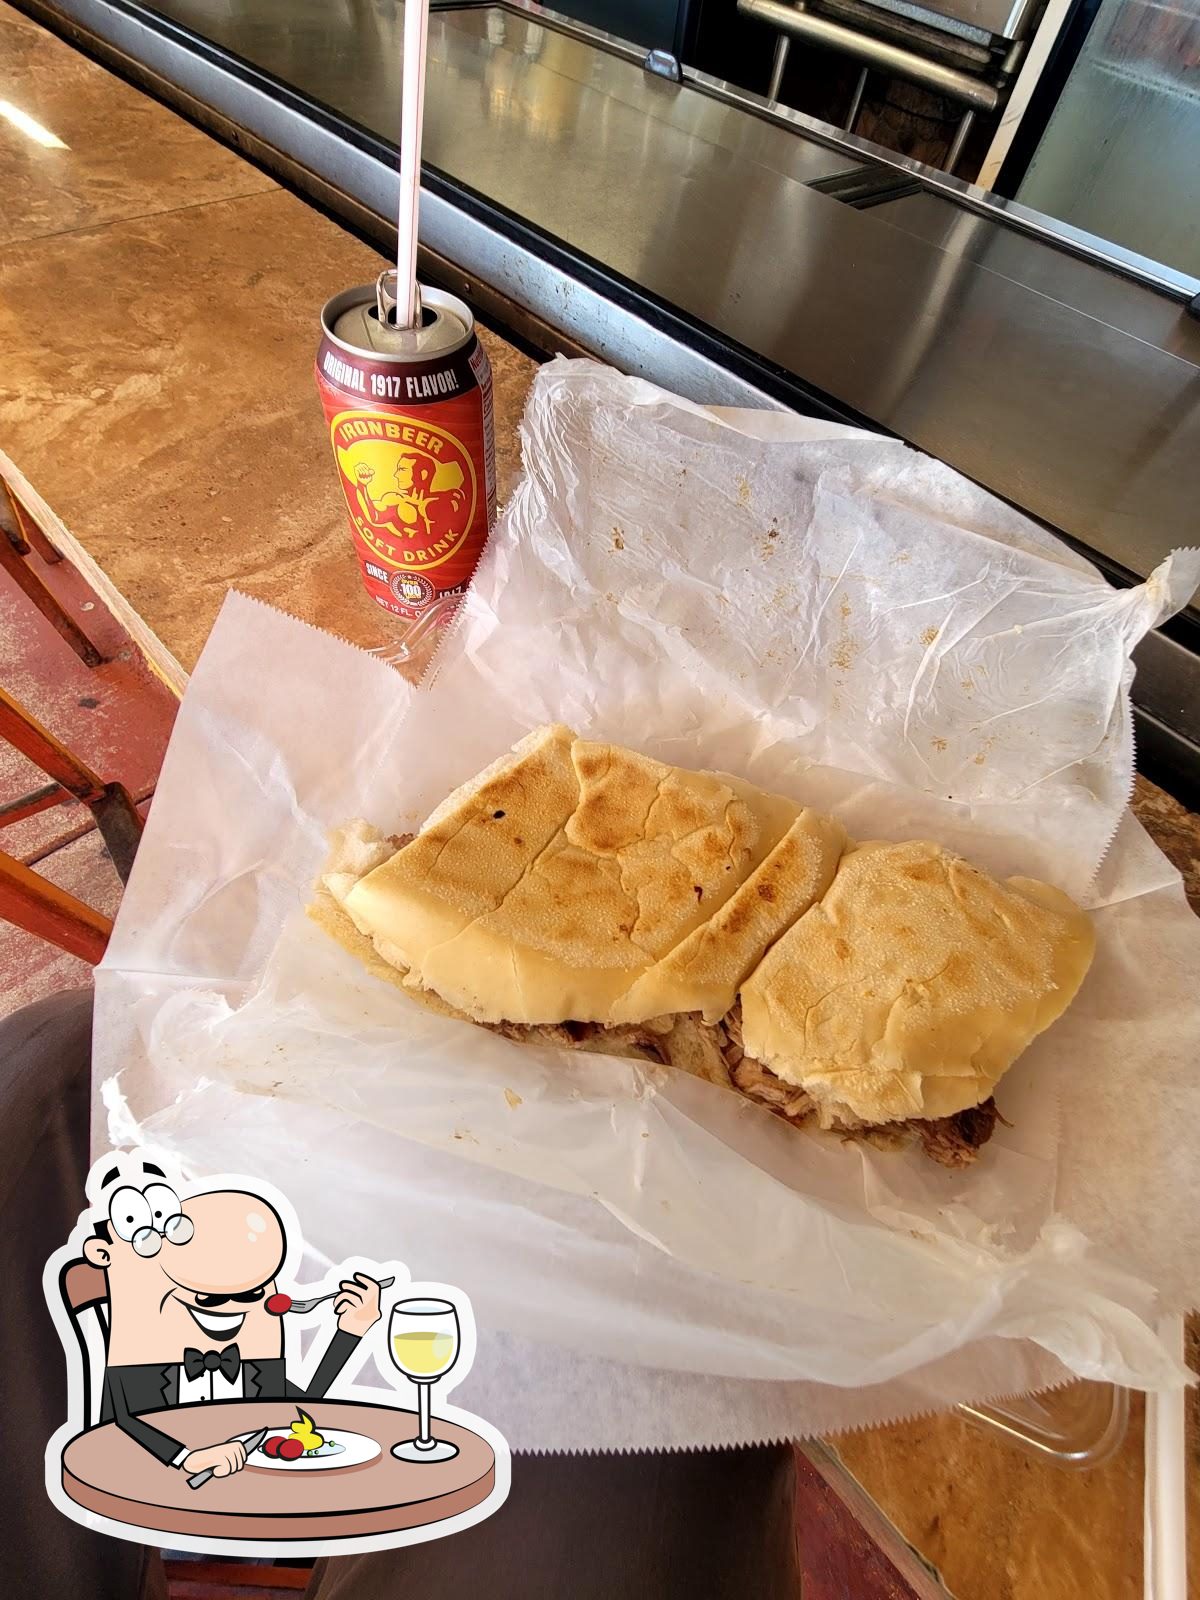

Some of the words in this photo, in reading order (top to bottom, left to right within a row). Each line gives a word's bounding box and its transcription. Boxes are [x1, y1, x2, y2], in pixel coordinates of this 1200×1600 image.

[323, 351, 366, 392] ORIGINAL
[370, 373, 400, 398] 1917
[405, 368, 459, 398] FLAVOR!
[355, 516, 396, 556] SOFT
[403, 528, 459, 562] DRINK
[365, 562, 389, 583] SINCE
[400, 584, 421, 597] 100
[375, 595, 389, 608] NET
[390, 605, 400, 613] 12
